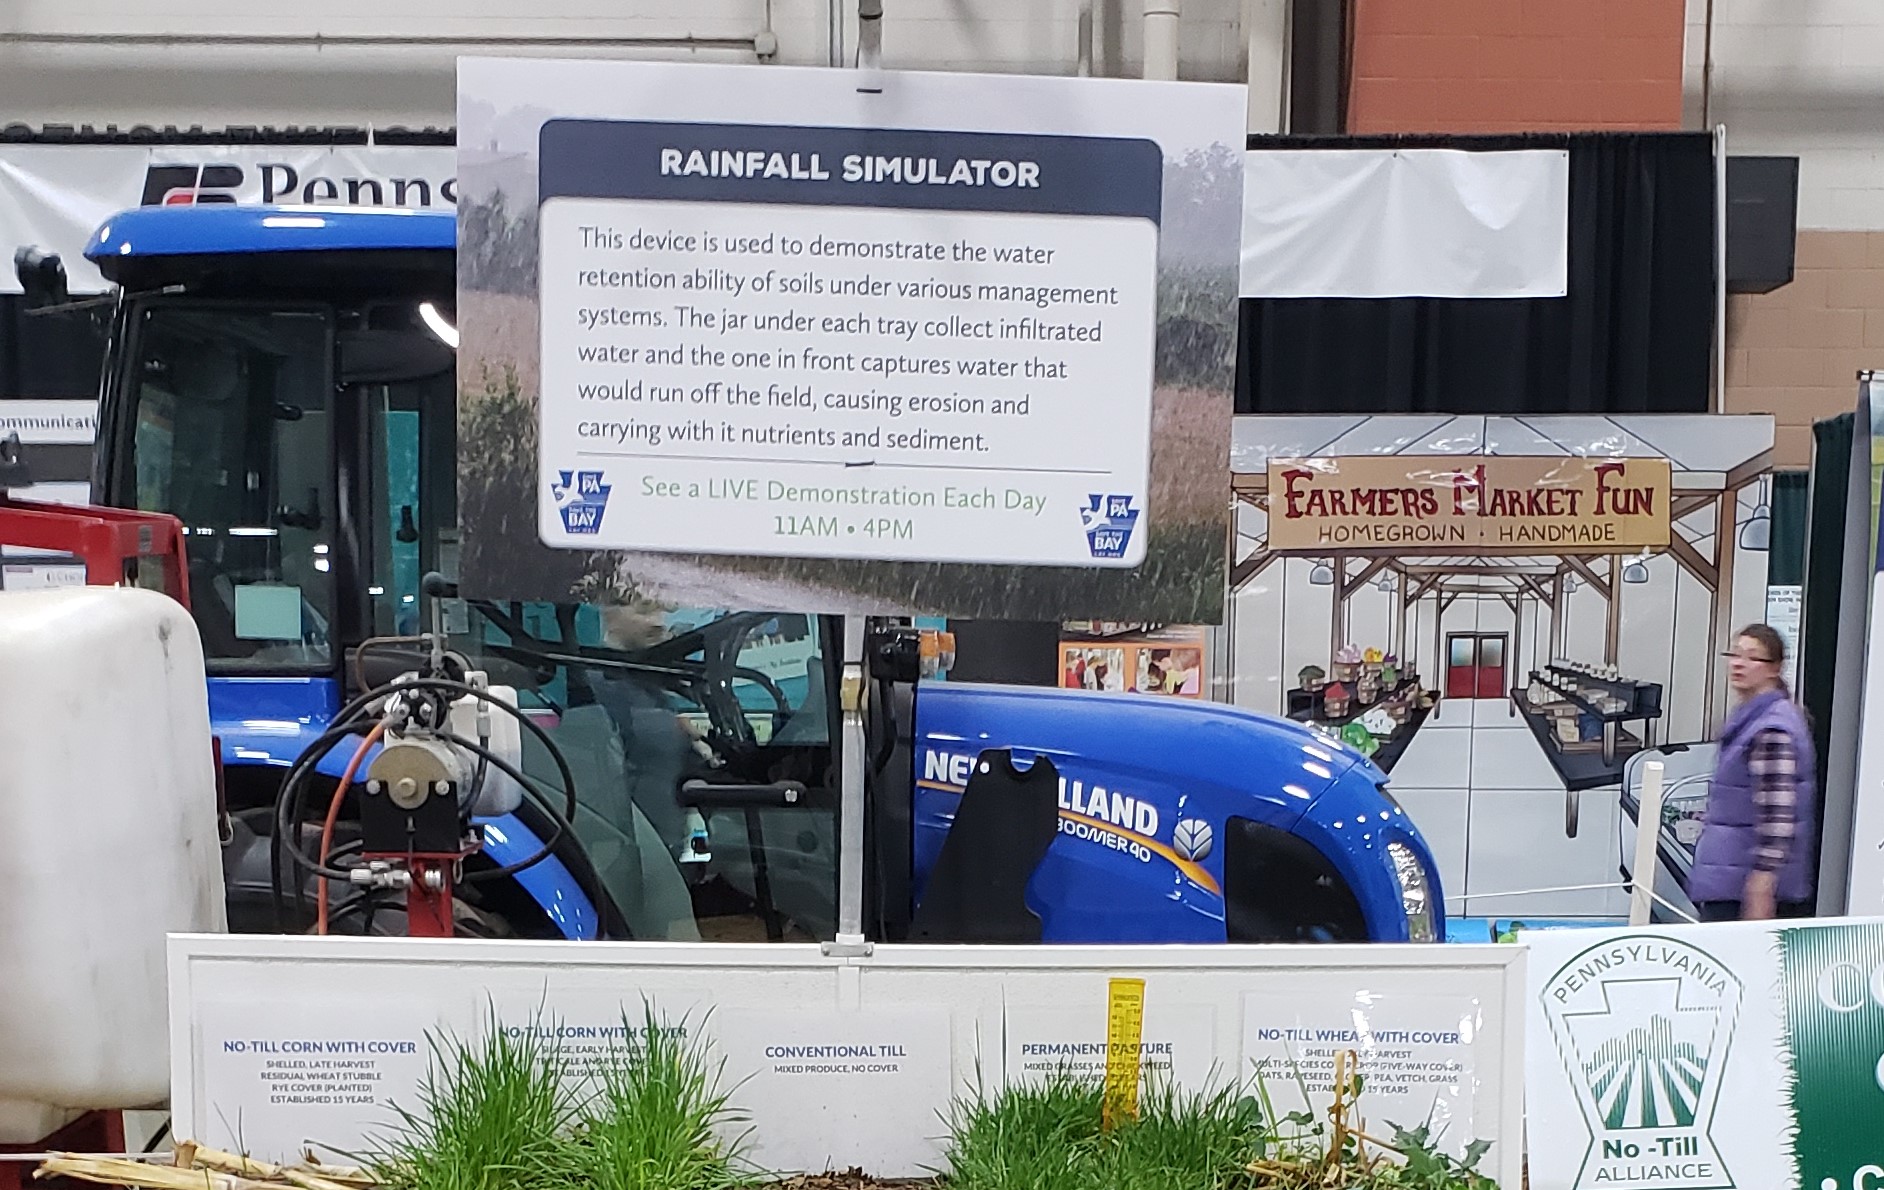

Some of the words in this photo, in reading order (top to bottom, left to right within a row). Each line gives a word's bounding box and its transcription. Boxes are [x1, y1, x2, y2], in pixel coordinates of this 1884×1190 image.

[661, 148, 830, 180] RAINFALL
[842, 154, 1040, 188] SIMULATOR
[578, 225, 623, 250] This
[629, 227, 697, 253] device
[703, 230, 719, 254] is
[725, 232, 774, 255] used
[780, 236, 803, 256] to
[809, 233, 946, 261] demonstrate
[951, 239, 987, 262] the
[993, 245, 1056, 265] water
[578, 266, 676, 290] retention
[682, 267, 746, 298] ability
[751, 270, 776, 293] of
[778, 271, 824, 295] soils
[830, 273, 892, 297] under
[896, 276, 972, 300] various
[978, 285, 1119, 309] management
[578, 306, 668, 331] systems.
[673, 306, 716, 329] The
[720, 307, 749, 336] jar
[754, 309, 816, 332] under
[821, 312, 871, 335] each
[877, 316, 919, 342] tray
[924, 315, 994, 339] collect
[999, 317, 1102, 343] infiltrated
[577, 345, 640, 364] water
[644, 348, 684, 366] and
[690, 348, 725, 367] the
[731, 352, 771, 369] one
[777, 353, 796, 370] in
[802, 352, 856, 372] front
[860, 355, 951, 380] captures
[956, 358, 1019, 377] water
[1024, 360, 1068, 379] that
[577, 381, 643, 402] would
[650, 386, 684, 403] run
[690, 384, 721, 403] off
[726, 385, 761, 406] the
[767, 386, 817, 413] field,
[823, 389, 903, 418] causing
[908, 392, 985, 414] erosion
[990, 395, 1030, 416] and
[577, 420, 662, 446] carrying
[667, 422, 714, 442] with
[721, 423, 736, 443] it
[741, 425, 836, 446] nutrients
[841, 428, 880, 448] and
[886, 430, 989, 452] sediment.
[641, 475, 681, 498] See
[687, 482, 700, 499] a
[709, 477, 759, 501] LIVE
[767, 480, 935, 507] Demonstration
[944, 486, 996, 509] Each
[1004, 488, 1047, 516] Day
[1281, 468, 1438, 519] FARMERS
[1452, 464, 1583, 517] MARKET
[1594, 462, 1654, 516] FUN
[1110, 503, 1128, 517] PA
[773, 515, 838, 538] 11AM
[863, 517, 914, 540] 4PM
[1318, 524, 1465, 543] HOMEGROWN
[1499, 522, 1616, 543] HANDMADE
[1094, 536, 1122, 550] BAY
[925, 750, 978, 786] NE
[1058, 777, 1158, 837] LLAND
[1552, 944, 1727, 1005] PENNSYLVANIA
[556, 1027, 596, 1038] CORN
[1258, 1029, 1312, 1041] NO-TILL
[1316, 1030, 1361, 1042] WHEA
[1372, 1031, 1409, 1043] WITH
[1411, 1031, 1460, 1044] COVER
[223, 1041, 279, 1053] NO-TILL
[281, 1041, 323, 1053] CORN
[325, 1041, 366, 1053] WITH
[367, 1041, 417, 1053] COVER
[765, 1046, 877, 1058] CONVENTIONAL
[879, 1045, 907, 1057] TILL
[1022, 1044, 1107, 1055] PERMANENT
[1375, 1050, 1412, 1058] ARVEST
[309, 1060, 331, 1069] LATE
[333, 1060, 375, 1069] HARVEST
[774, 1065, 804, 1073] MIXED
[805, 1064, 850, 1074] PRODUCE,
[851, 1064, 866, 1073] NO
[867, 1064, 899, 1073] COVER
[1024, 1062, 1053, 1070] MIXED
[260, 1072, 305, 1081] RESIDUAL
[306, 1072, 340, 1081] WHEAT
[342, 1072, 382, 1081] STUBBLE
[271, 1084, 289, 1092] RYE
[291, 1084, 323, 1092] COVER
[324, 1083, 373, 1093] (PLANTED)
[1380, 1085, 1409, 1094] YEARS
[270, 1095, 332, 1104] ESTABLISHED
[333, 1095, 344, 1104] 15
[345, 1095, 375, 1104] YEARS
[1603, 1139, 1640, 1160] No
[1595, 1163, 1713, 1182] ALLIANCE
